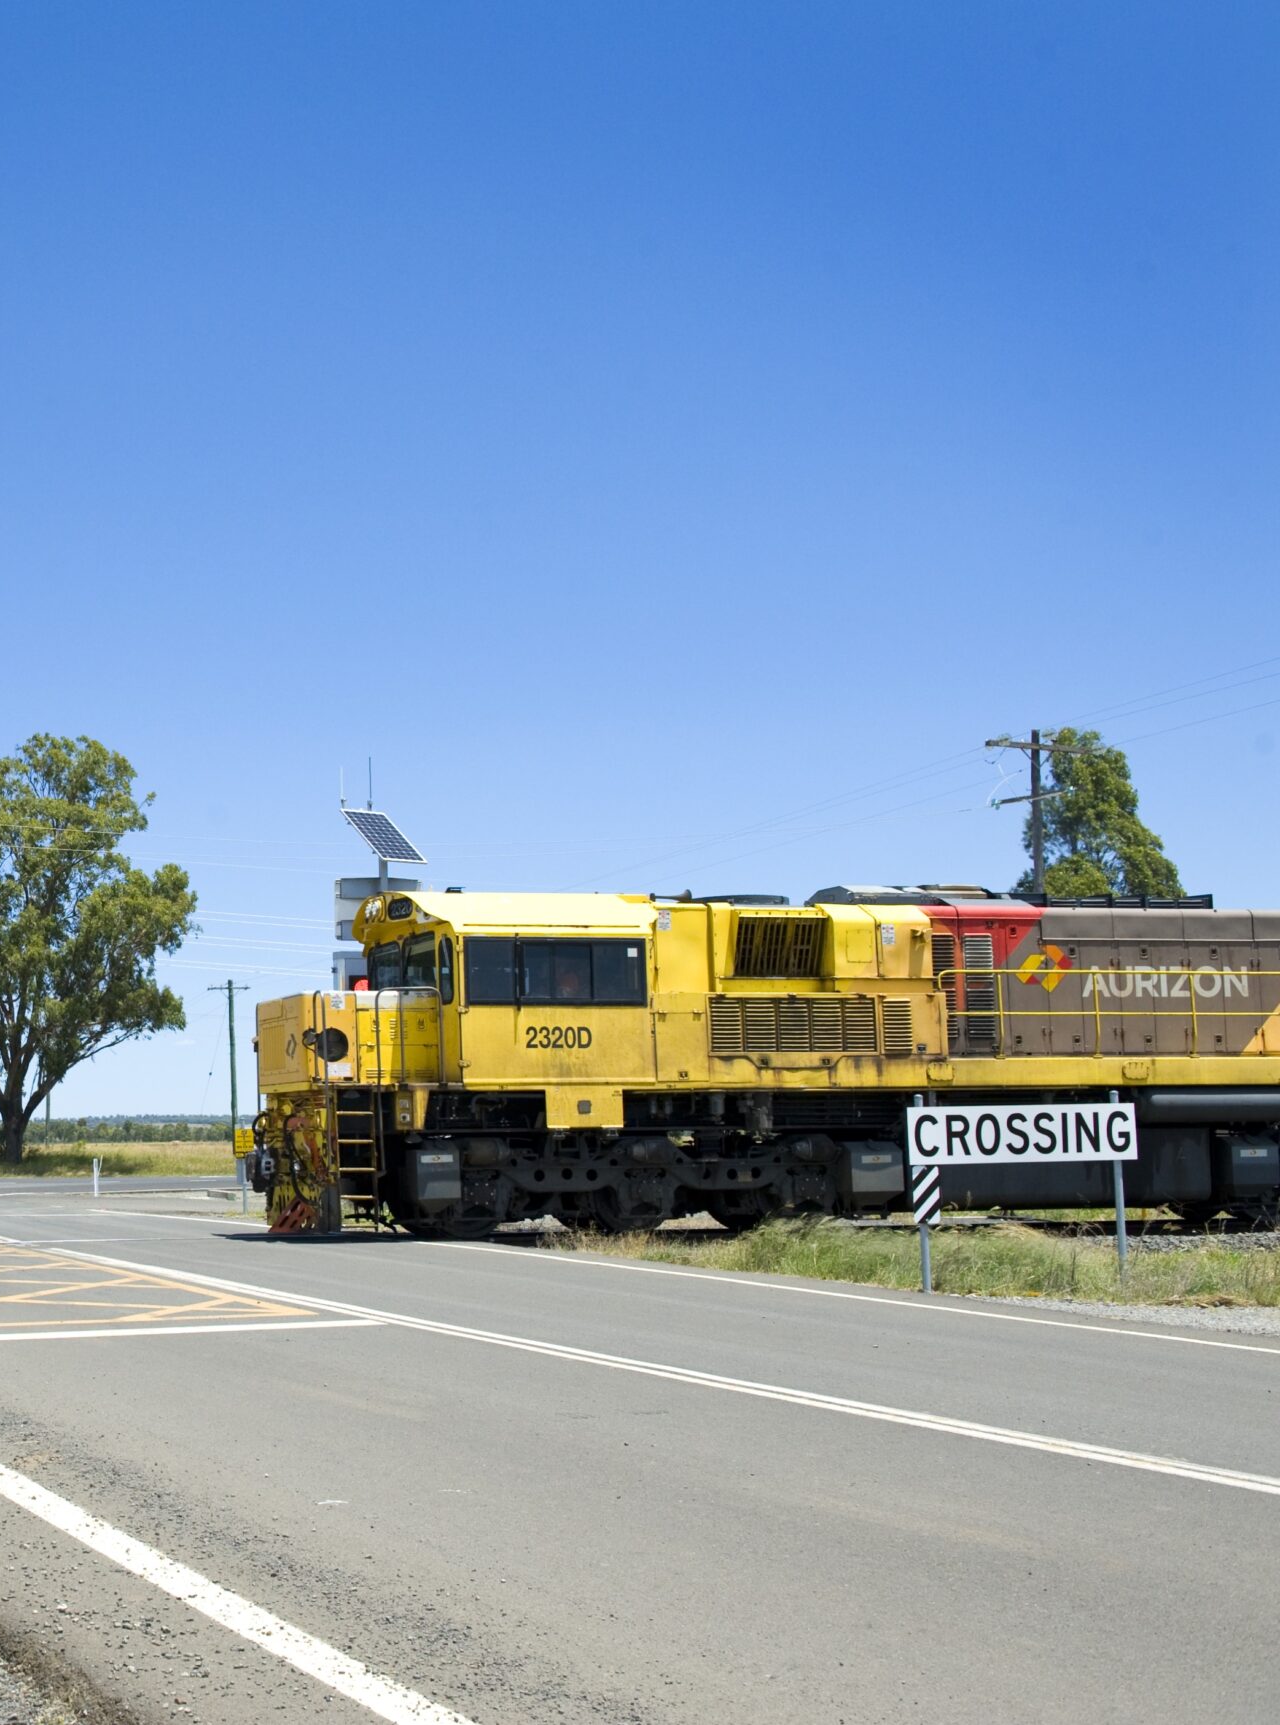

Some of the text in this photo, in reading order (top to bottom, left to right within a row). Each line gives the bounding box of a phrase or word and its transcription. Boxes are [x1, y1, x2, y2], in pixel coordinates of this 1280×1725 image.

[1082, 965, 1249, 998] AURIZON
[526, 1026, 592, 1049] 2320D
[914, 1111, 1131, 1157] CROSSING
